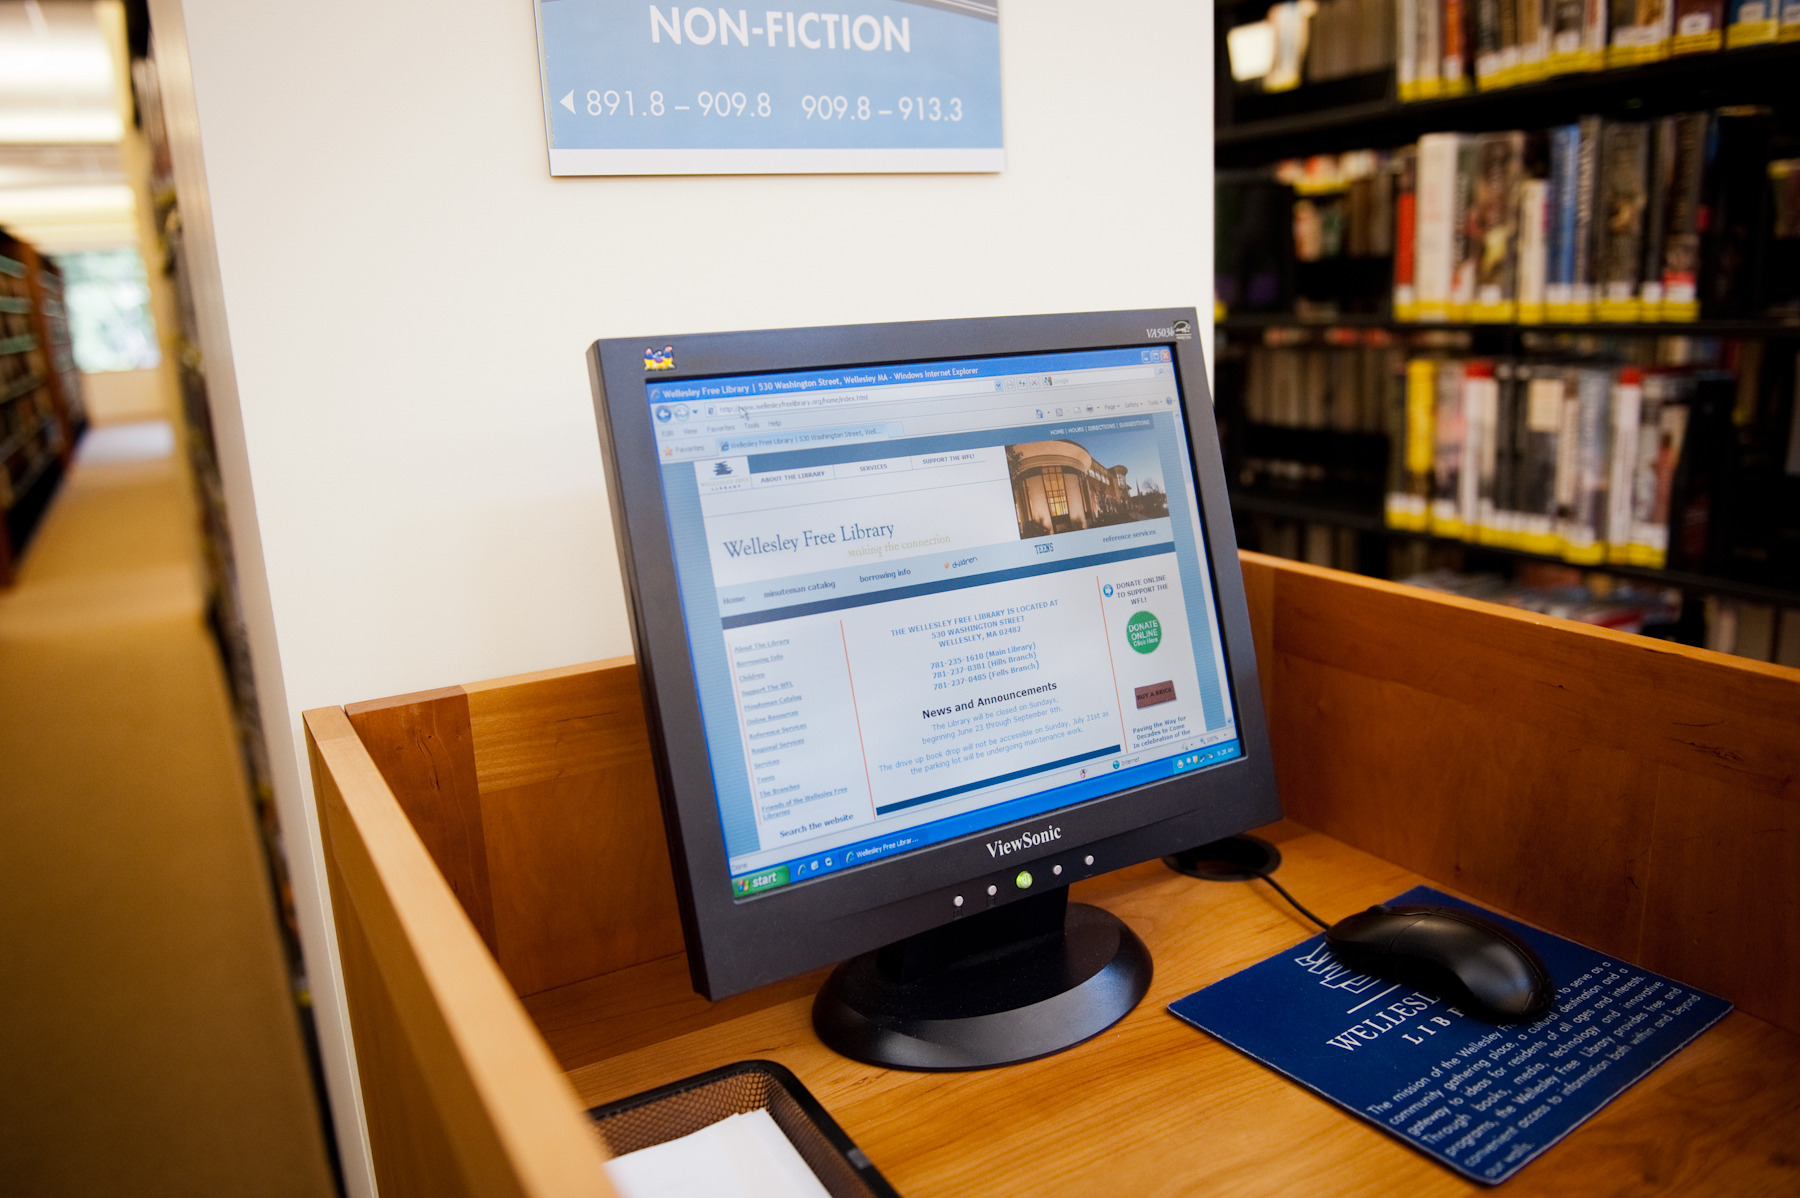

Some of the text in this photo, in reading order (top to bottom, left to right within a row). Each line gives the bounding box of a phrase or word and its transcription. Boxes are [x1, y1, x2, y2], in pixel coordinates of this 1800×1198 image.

[649, 5, 911, 53] NON-FICTION
[587, 89, 666, 117] 891.8
[697, 91, 772, 118] 909.8
[802, 95, 871, 121] 909.8
[899, 97, 963, 122] 913.3
[662, 367, 979, 399] Wellesley Free Library 530 Washington Street, Wellesley MA Windows Internet Explorer
[1088, 423, 1116, 431] DIRECTIONS
[1119, 420, 1150, 428] SUGGESTIONS
[860, 464, 887, 472] SERVICES
[922, 456, 948, 465] SUPPORT
[760, 475, 782, 483] ABOUT
[798, 471, 825, 480] LIBRARY
[723, 523, 894, 559] Wellesley Free Library
[884, 541, 900, 552] the
[901, 534, 951, 550] connection
[722, 528, 1157, 605] Home minuteman catalog borrowing info children TEENS reference services
[1116, 575, 1166, 590] DONATE ONLINE
[1117, 583, 1169, 598] TO SUPPORT THE
[890, 599, 1059, 637] THE WELLESLEY FREE LIBRARY IS LOCATED AT
[931, 615, 1025, 639] 530 WASHINGTON STREET
[1128, 619, 1159, 633] DONATE
[938, 626, 1021, 648] WELLESLEY, MA 02482
[1131, 628, 1159, 641] ONLINE
[1133, 637, 1159, 648] Click Here
[930, 641, 1036, 670] 781-235-1610 (Main Library)
[932, 651, 1037, 679] 781-237-0381 (Hills Branch)
[933, 660, 1040, 690] 781-237-0485 (Fells Branch)
[922, 682, 1057, 719] News and Announcements
[1155, 687, 1173, 697] BRICK
[922, 731, 956, 745] beginning
[957, 727, 973, 737] June
[975, 723, 984, 732] 23
[985, 717, 1012, 730] through
[1013, 710, 1048, 723] September
[1133, 724, 1152, 734] Paving
[1154, 721, 1163, 729] the
[1164, 718, 1177, 727] Way
[1137, 730, 1161, 740] Decades
[1169, 724, 1185, 732] Come
[753, 758, 780, 769] Services
[780, 813, 854, 838] Search the website
[856, 846, 882, 859] Wellesley
[883, 842, 896, 852] Free
[986, 825, 1062, 858] ViewSonic
[752, 872, 777, 888] start
[1326, 991, 1441, 1051] WELLESL
[1366, 1100, 1393, 1115] The
[1393, 1077, 1431, 1102] mission
[1431, 1066, 1444, 1078] of
[1441, 1057, 1461, 1070] the
[1455, 1031, 1501, 1057] Wellesley
[1557, 986, 1571, 994] to
[1570, 973, 1592, 988] serve
[1591, 966, 1604, 974] as
[1389, 1088, 1445, 1126] community
[1443, 1058, 1492, 1091] gathering
[1488, 1040, 1519, 1061] place,
[1517, 1033, 1528, 1041] a
[1527, 1010, 1561, 1034] cultural
[1557, 984, 1603, 1013] destination
[1602, 971, 1620, 986] and
[1494, 1104, 1517, 1119] the
[1511, 1073, 1561, 1106] Wellesley
[1554, 1059, 1581, 1076] Free
[1579, 1034, 1616, 1058] Library
[1613, 1010, 1649, 1038] provides
[1643, 999, 1666, 1013] free
[1664, 986, 1682, 1001] and
[1407, 974, 1647, 1137] gateway to ideas for residents of all ages and interests.
[1420, 980, 1664, 1145] Through books, media, technology and innovative
